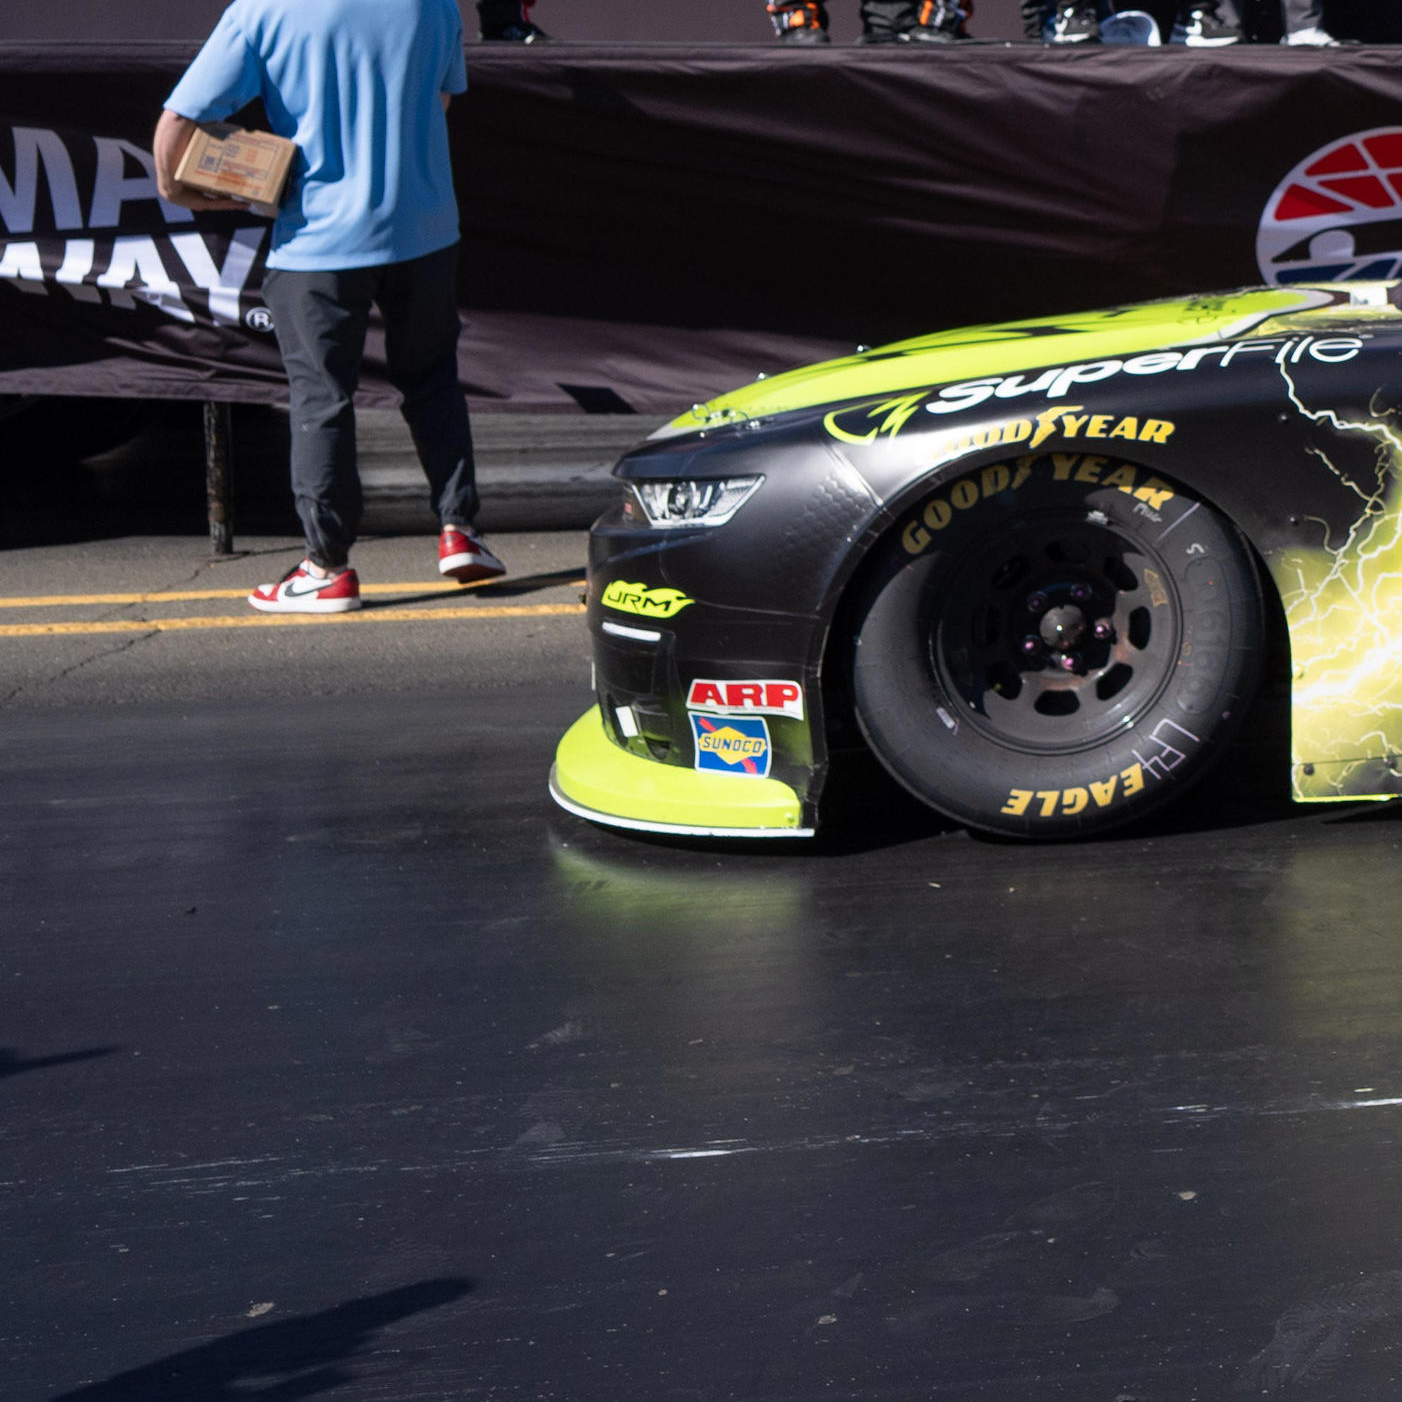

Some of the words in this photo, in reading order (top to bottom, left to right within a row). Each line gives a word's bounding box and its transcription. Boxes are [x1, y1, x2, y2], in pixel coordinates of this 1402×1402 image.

[926, 336, 1365, 414] SuperFile
[607, 590, 672, 614] JRM
[690, 682, 799, 708] ARP
[703, 735, 763, 754] SUNOCO
[1001, 763, 1146, 818] EAGLE
